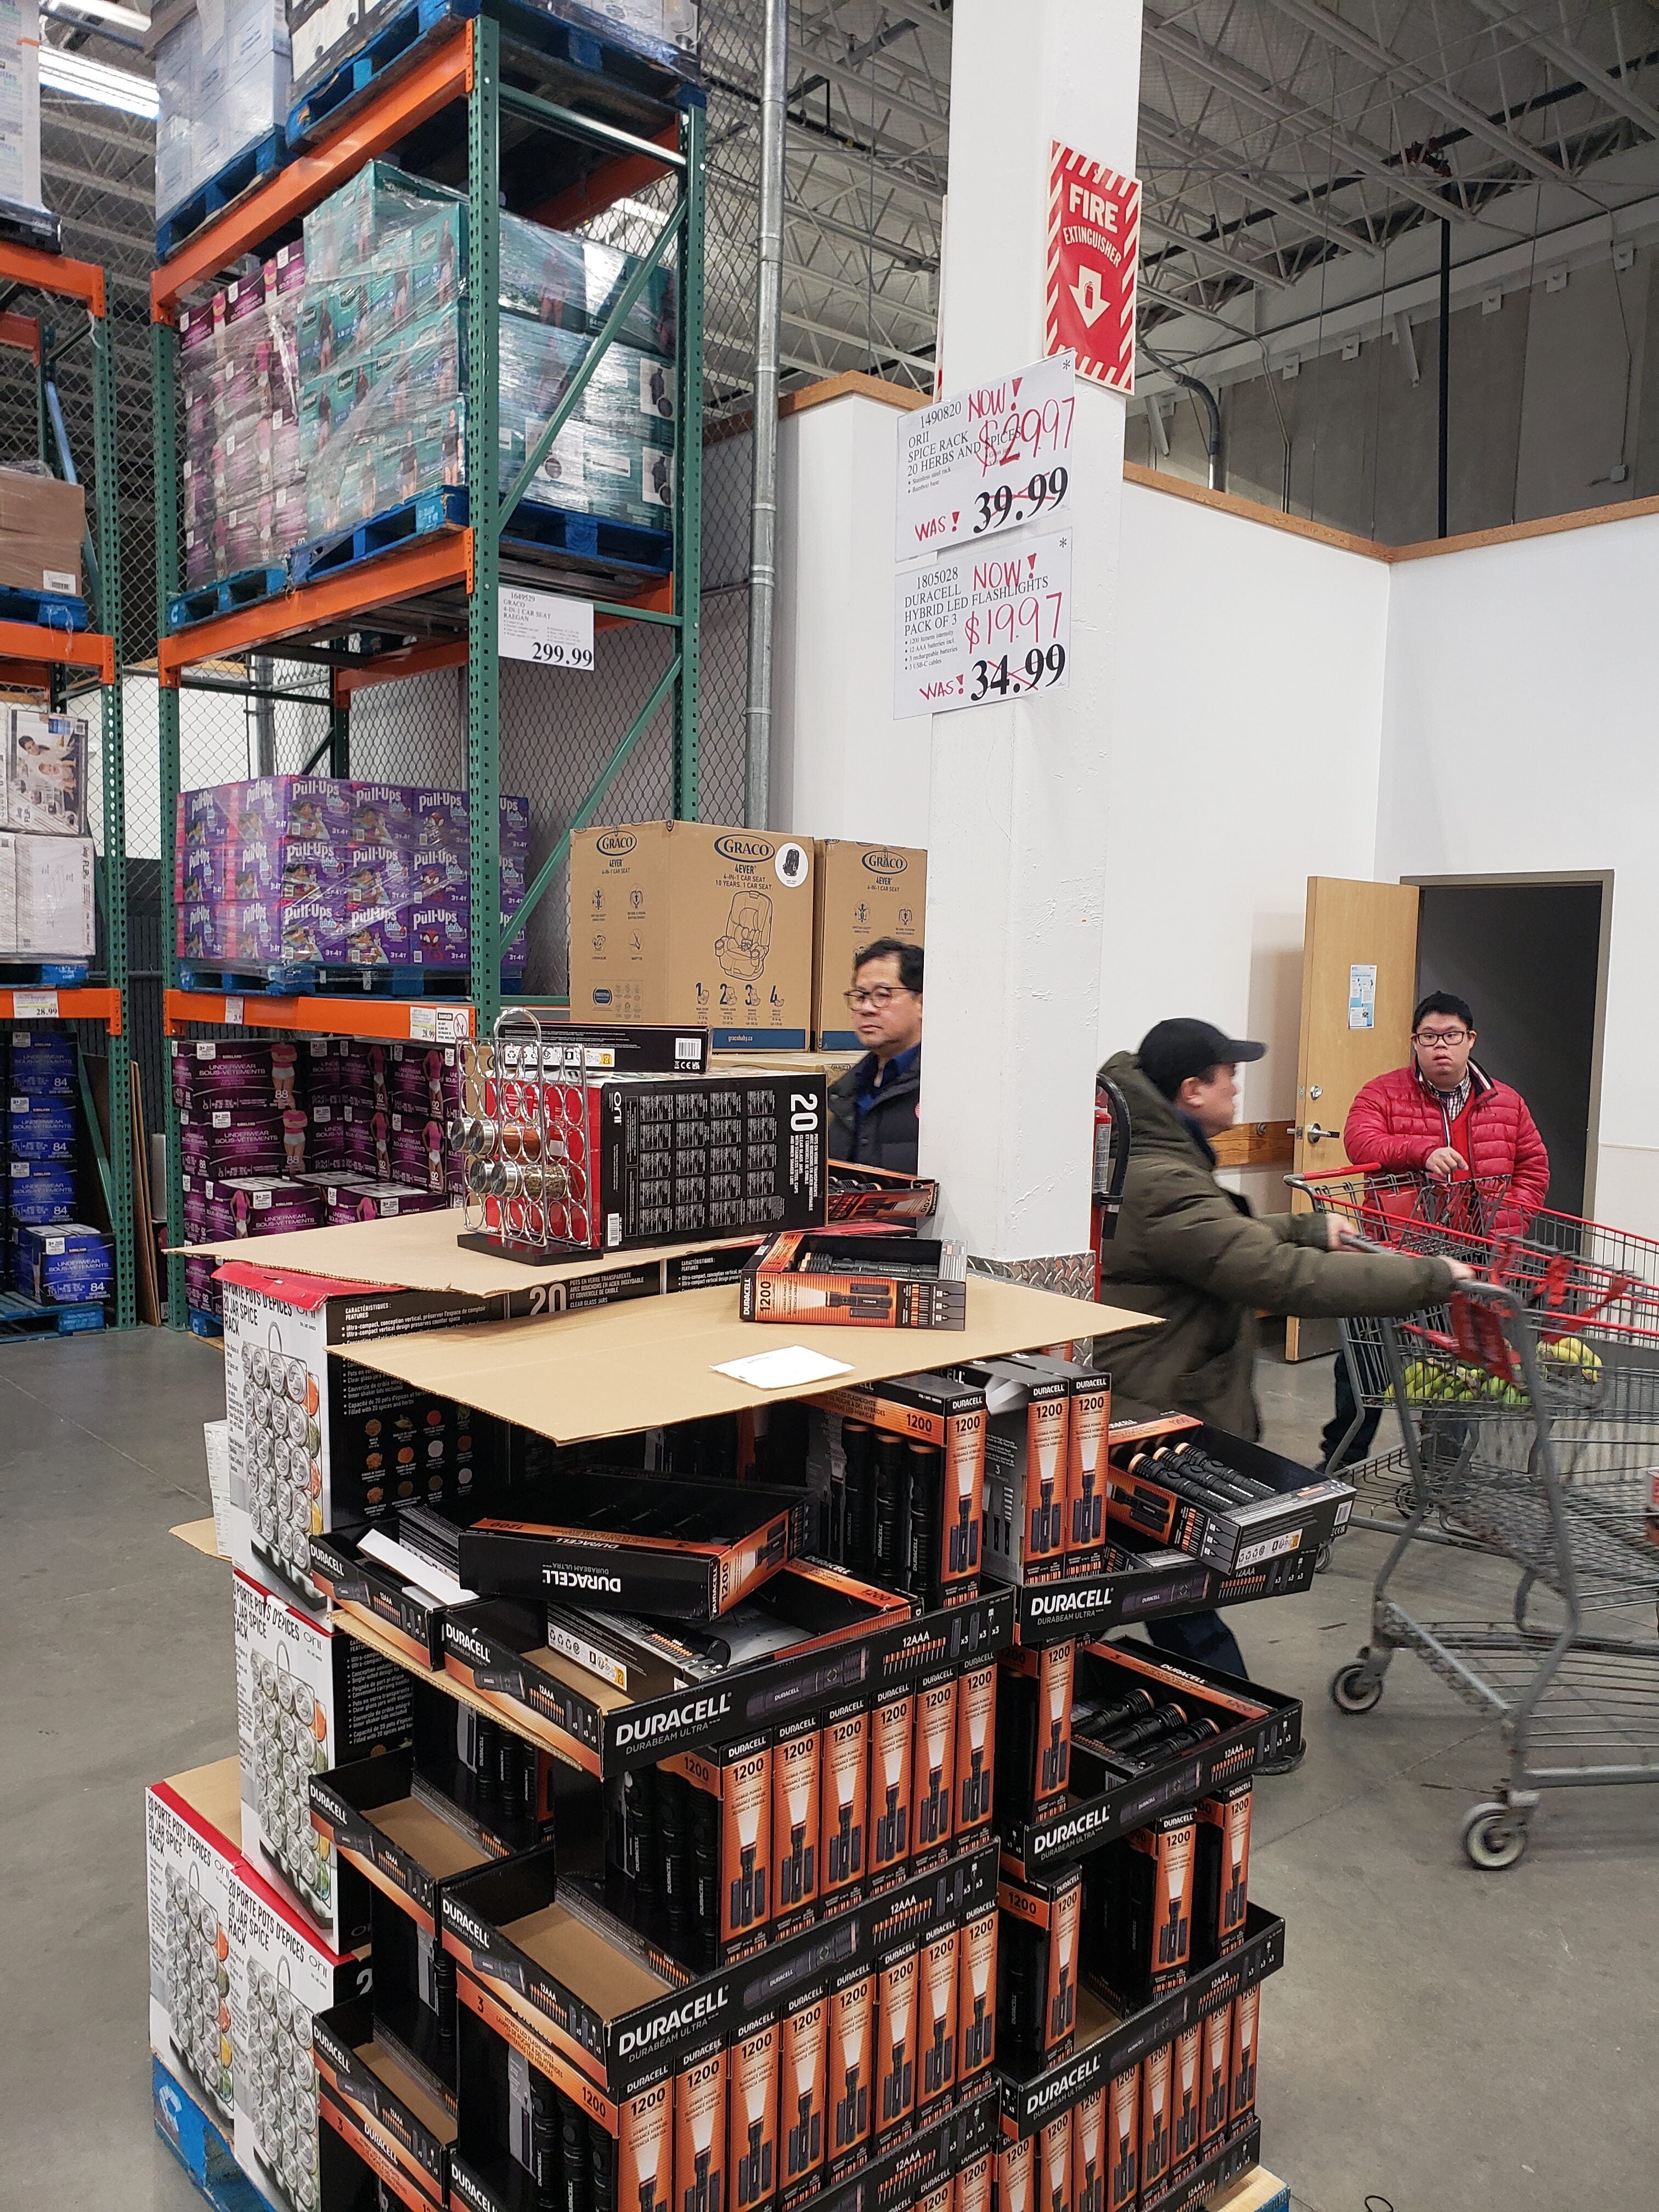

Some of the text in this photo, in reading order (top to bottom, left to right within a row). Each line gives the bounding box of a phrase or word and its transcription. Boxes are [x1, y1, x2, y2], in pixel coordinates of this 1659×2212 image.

[1069, 182, 1119, 234] FIRE
[1063, 227, 1121, 268] EXTINGUISHER
[968, 377, 1023, 422] NOW!
[920, 402, 962, 428] 1490820
[908, 431, 929, 448] ORII
[908, 431, 969, 463] SPICE RACK
[907, 464, 919, 477] 20
[921, 451, 954, 472] HERBS
[957, 441, 981, 460] AND
[984, 426, 1021, 449] SPICES
[973, 467, 1068, 533] 39.99
[915, 511, 960, 541] WAS!
[917, 567, 958, 590] 1805028
[973, 553, 1037, 591] NOW!
[504, 599, 526, 608] GRACO
[511, 592, 535, 602] 1649529
[905, 584, 961, 608] DURACELL
[905, 575, 1048, 623] HYBRID LED FLASHLIGHTS
[504, 606, 520, 614] 4-IN-1
[905, 613, 957, 636] PACK OF 3
[910, 630, 953, 645] 1200 lumens intensity
[915, 644, 927, 652] AAA
[927, 640, 945, 648] batteries
[532, 642, 592, 667] 299.99
[913, 650, 939, 661] rechargeable
[940, 646, 958, 656] batteries
[970, 644, 1066, 701] 34.99
[919, 674, 964, 700] WAS!
[602, 837, 633, 849] GRACO
[724, 839, 770, 856] GRACO
[869, 855, 903, 868] GRACO
[696, 983, 777, 1005] 1 2 3 4
[36, 1008, 58, 1016] 28.99
[422, 1029, 435, 1039] 28.99
[275, 1090, 289, 1099] 88
[791, 1093, 818, 1132] 20
[224, 1130, 269, 1138] UNDERWEAR
[431, 1172, 438, 1181] 92
[91, 1283, 104, 1291] 84
[569, 1278, 580, 1286] POTS
[587, 1274, 600, 1284] VERRE
[601, 1272, 631, 1282] TRANSPARENTE
[529, 1283, 567, 1316] 20
[570, 1300, 583, 1308] CLEAR
[584, 1298, 597, 1306] GLASS
[760, 1281, 772, 1312] 1200
[346, 1328, 379, 1338] Ultra-compact
[396, 1323, 410, 1331] design
[411, 1319, 432, 1329] preserves
[432, 1317, 448, 1325] counter
[1033, 1384, 1065, 1396] DURACELL
[952, 1396, 983, 1409] DURACELL
[1036, 1403, 1063, 1419] 1200
[906, 1414, 932, 1432] 1200
[956, 1415, 980, 1433] 1200
[310, 1544, 344, 1576] DURACELL
[574, 1566, 610, 1575] DURABEAM
[542, 1569, 621, 1593] DURACELL
[1031, 1588, 1113, 1617] DURACELL
[1037, 1612, 1073, 1625] DURABEAM
[446, 1623, 490, 1663] DURACELL
[902, 1630, 930, 1648] 12AAA
[964, 1651, 994, 1669] DURACELL
[539, 1684, 554, 1700] 12AAA
[967, 1670, 992, 1691] 1200
[775, 1687, 799, 1701] DURACELL
[616, 1692, 731, 1746] DURACELL
[626, 1730, 678, 1755] DURABEAM
[729, 1736, 766, 1758] DURACELL
[1224, 1743, 1244, 1758] 12AAA
[733, 1758, 764, 1782] 1200
[1035, 1805, 1110, 1854] DURACELL
[1166, 1830, 1190, 1847] 1200
[229, 1879, 235, 1898] 20
[236, 1886, 257, 1918] PORTE
[258, 1905, 274, 1934] POTS
[228, 1899, 269, 1951] 20 JAR SPICE
[228, 1916, 246, 1949] RACK
[443, 1898, 489, 1949] DURACELL
[477, 1995, 484, 2013] 3
[618, 1986, 729, 2057] DURACELL
[628, 2032, 678, 2064] DURABEAM
[627, 2064, 669, 2094] DURACELL
[1026, 2055, 1100, 2115] DURACELL
[582, 2086, 606, 2118] 1200
[630, 2086, 666, 2117] 1200
[364, 2123, 398, 2166] DURACELL
[1007, 2140, 1029, 2164] 1200
